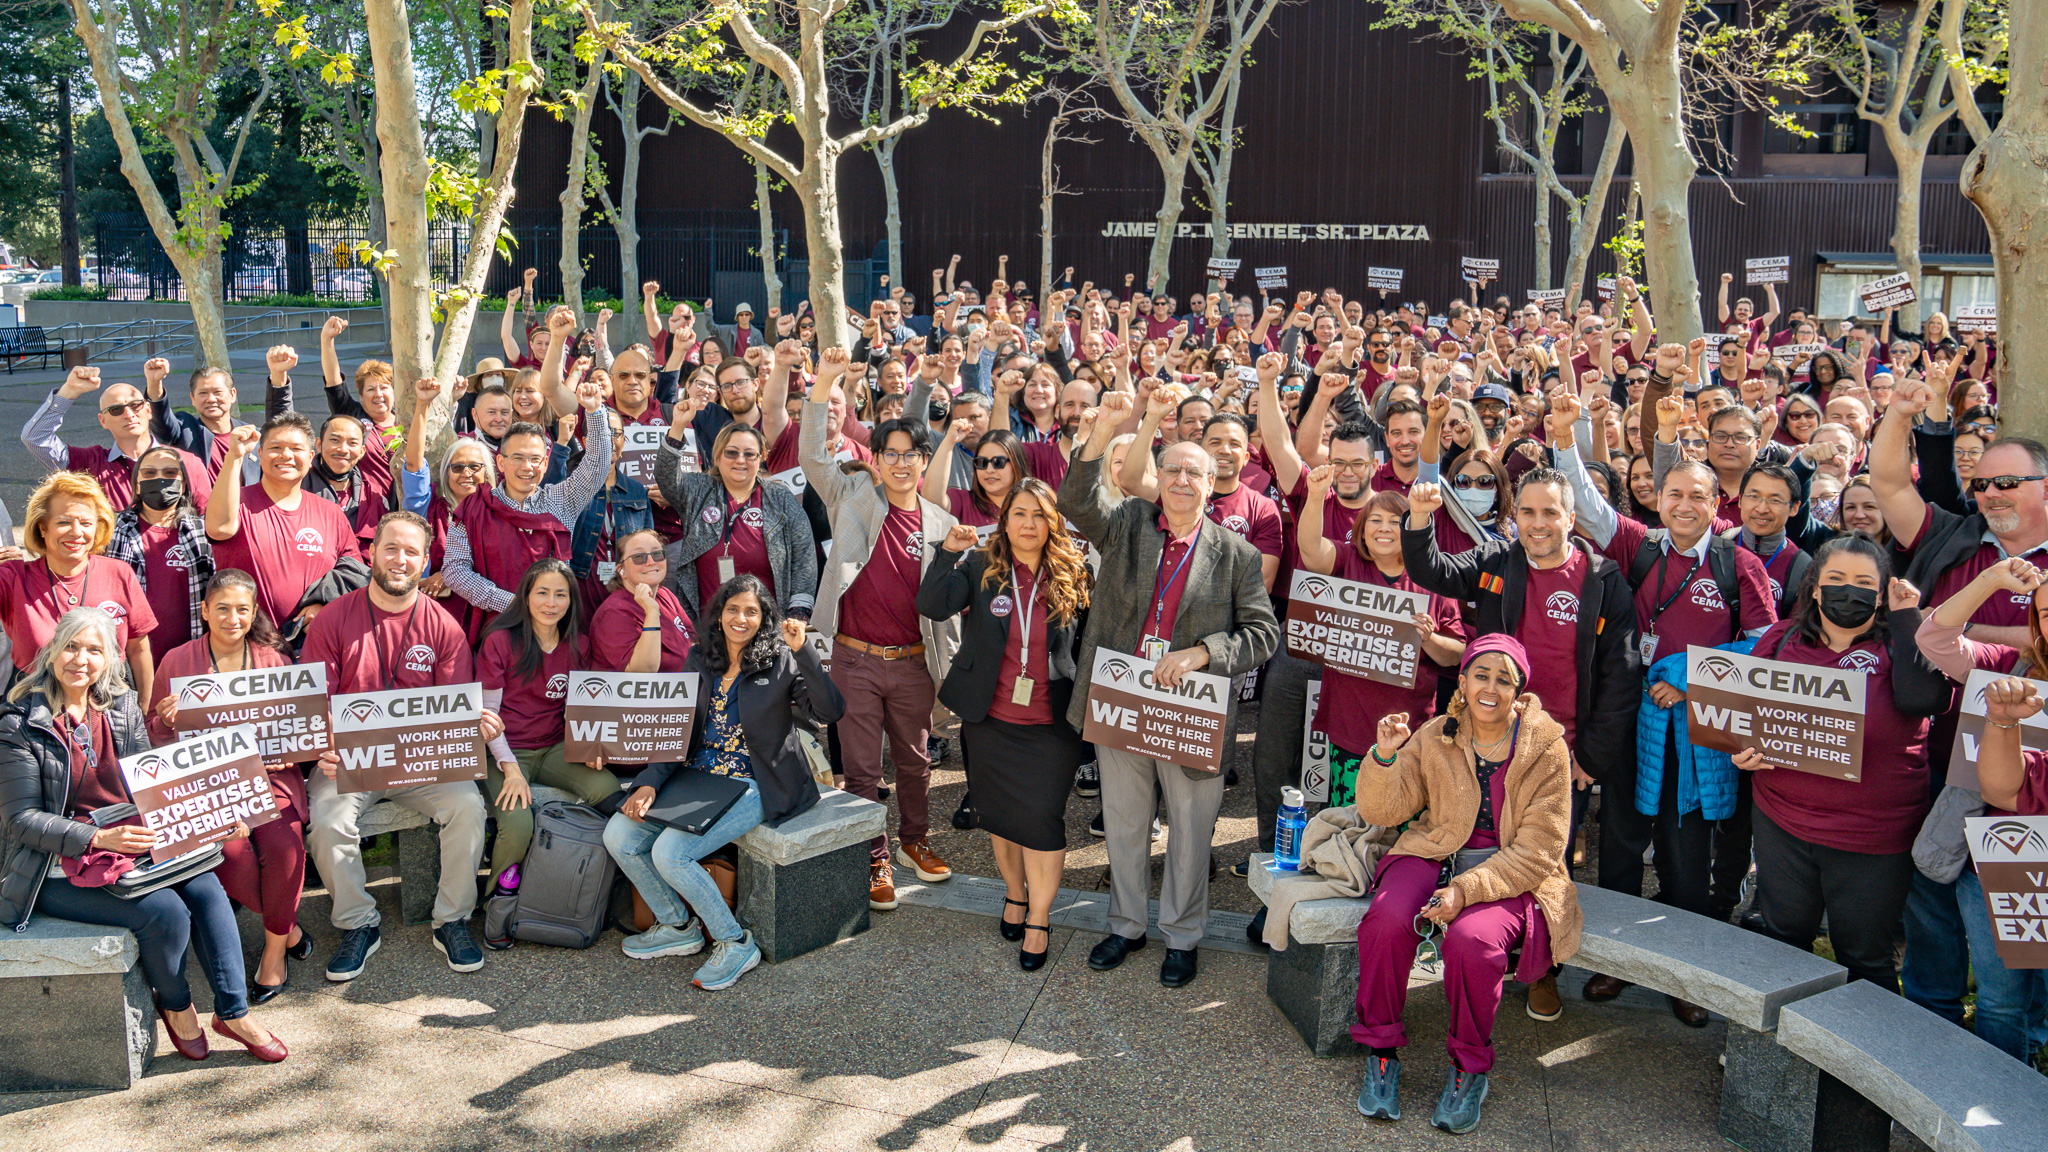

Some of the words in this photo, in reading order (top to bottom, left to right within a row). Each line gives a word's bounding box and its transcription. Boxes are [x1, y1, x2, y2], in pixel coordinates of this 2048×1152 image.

[1101, 222, 1157, 237] JAME
[1178, 223, 1197, 238] P.
[1316, 224, 1350, 240] SR.
[1359, 225, 1430, 241] PLAZA
[1762, 258, 1786, 266] CEMA
[1875, 275, 1906, 289] CEMA
[1598, 290, 1611, 299] WE
[1957, 324, 1997, 332] SERVICE
[296, 543, 323, 553] CEMA
[905, 545, 922, 557] CEM
[166, 559, 188, 568] CEM
[1338, 585, 1416, 616] CEMA
[1691, 595, 1725, 610] CEMA
[2010, 595, 2031, 605] CEM
[1315, 610, 1360, 630] VALUE
[1362, 620, 1394, 637] OUR
[1546, 609, 1578, 623] CEMA
[1287, 618, 1400, 657] EXPERTISE
[1400, 643, 1416, 661] &
[405, 661, 432, 673] CEMA
[1287, 634, 1415, 679] EXPERIENCE
[228, 669, 317, 697] CEMA
[617, 680, 689, 699] CEMA
[1747, 667, 1852, 703] CEMA
[387, 692, 473, 718] CEMA
[545, 690, 567, 699] CEM
[206, 707, 260, 725] VALUE
[262, 703, 297, 717] OUR
[309, 714, 327, 732] &
[622, 713, 659, 724] WORK
[661, 713, 690, 723] HERE
[1091, 698, 1139, 733] WE
[1142, 704, 1183, 723] WORK
[1185, 714, 1219, 730] HERE
[1690, 700, 1753, 737] WE
[1756, 705, 1809, 724] WORK
[1812, 714, 1857, 733] HERE
[397, 729, 441, 744] WORK
[443, 726, 479, 740] HERE
[569, 720, 619, 743] WE
[626, 728, 652, 738] LIVE
[653, 727, 683, 737] HERE
[1145, 720, 1174, 735] LIVE
[1176, 726, 1212, 743] HERE
[1763, 722, 1799, 739] LIVE
[1803, 729, 1848, 748] HERE
[172, 731, 250, 770] CEMA
[405, 745, 434, 759] LIVE
[437, 742, 473, 755] HERE
[623, 741, 653, 751] VOTE
[655, 740, 683, 751] HERE
[1142, 733, 1176, 751] VOTE
[1178, 742, 1214, 759] HERE
[1759, 736, 1803, 756] VOTE
[1807, 745, 1852, 765] HERE
[338, 743, 397, 771] WE
[403, 759, 440, 773] VOTE
[442, 756, 479, 770] HERE
[162, 777, 208, 801] VALUE
[208, 767, 240, 786] OUR
[144, 779, 254, 830] EXPERTISE
[252, 775, 269, 793] &
[153, 791, 276, 851] EXPERIENCE
